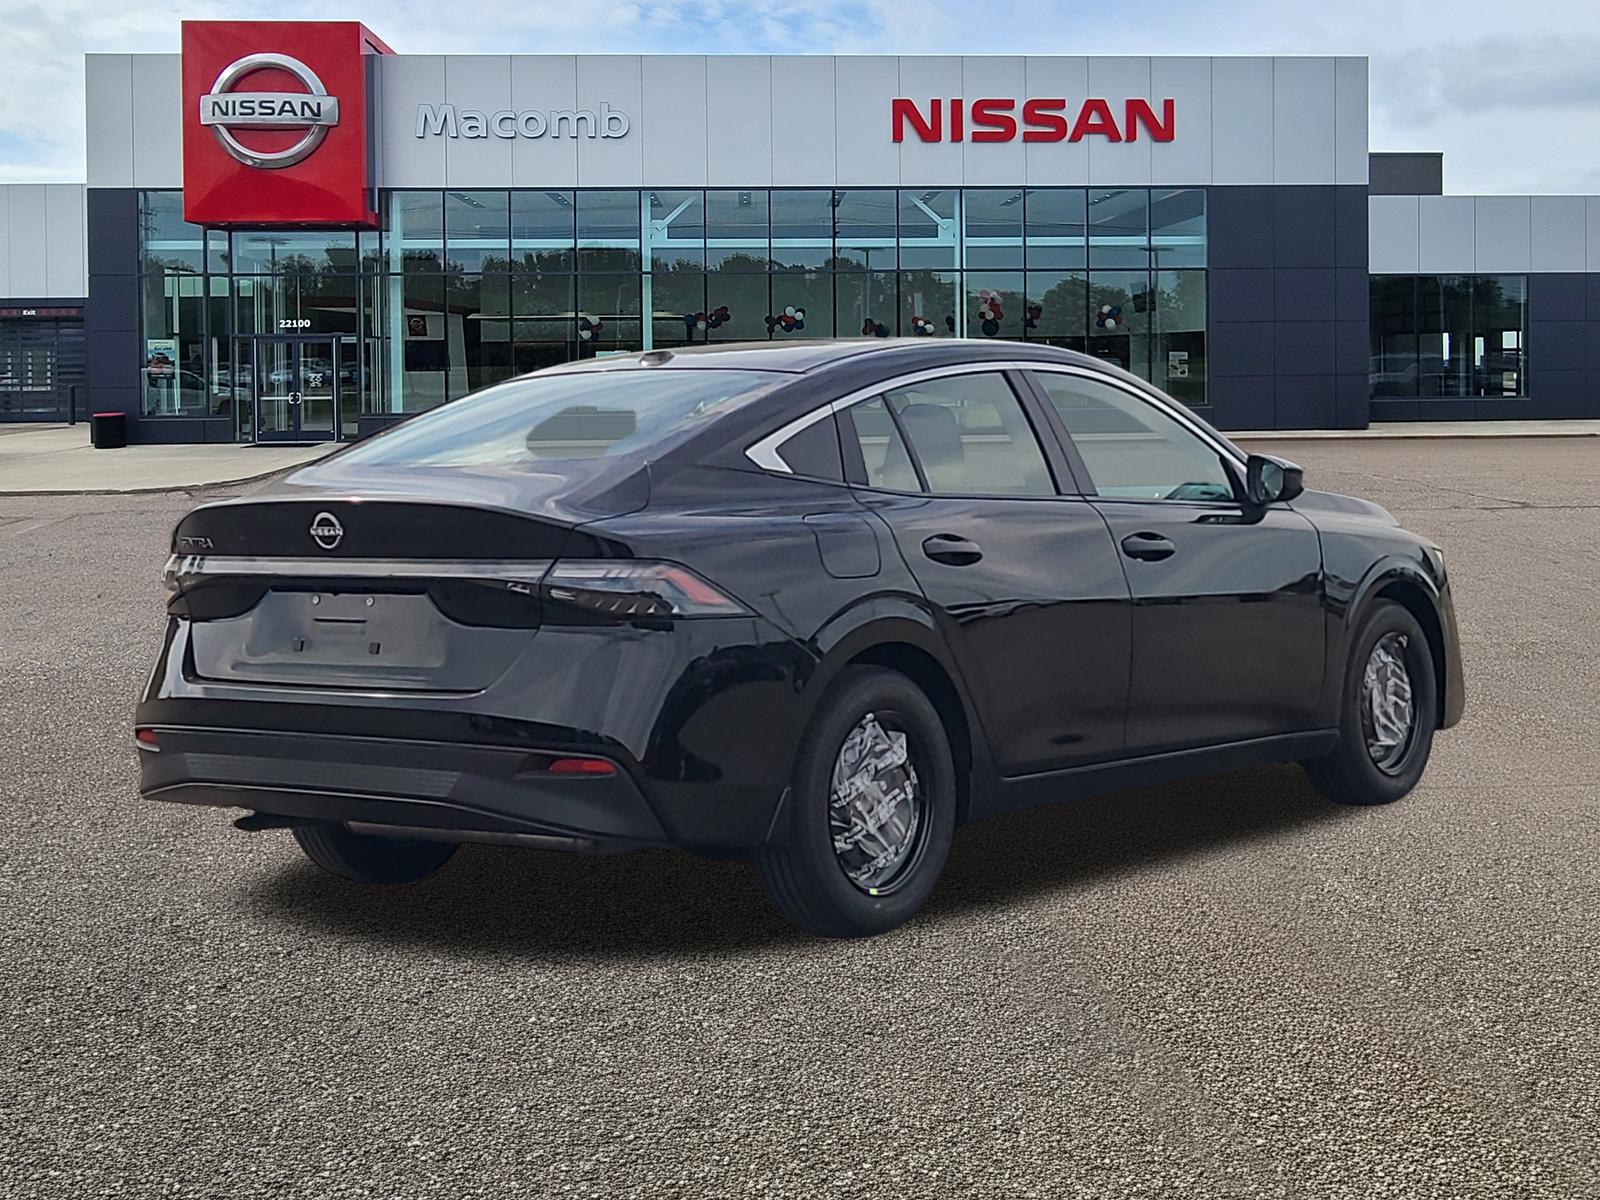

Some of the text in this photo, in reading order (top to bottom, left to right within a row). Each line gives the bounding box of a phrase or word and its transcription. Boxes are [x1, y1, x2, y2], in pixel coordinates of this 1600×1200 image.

[212, 100, 321, 117] NISSAN
[415, 102, 630, 138] Macomb
[892, 98, 1175, 142] NISSAN
[279, 319, 311, 328] 22100
